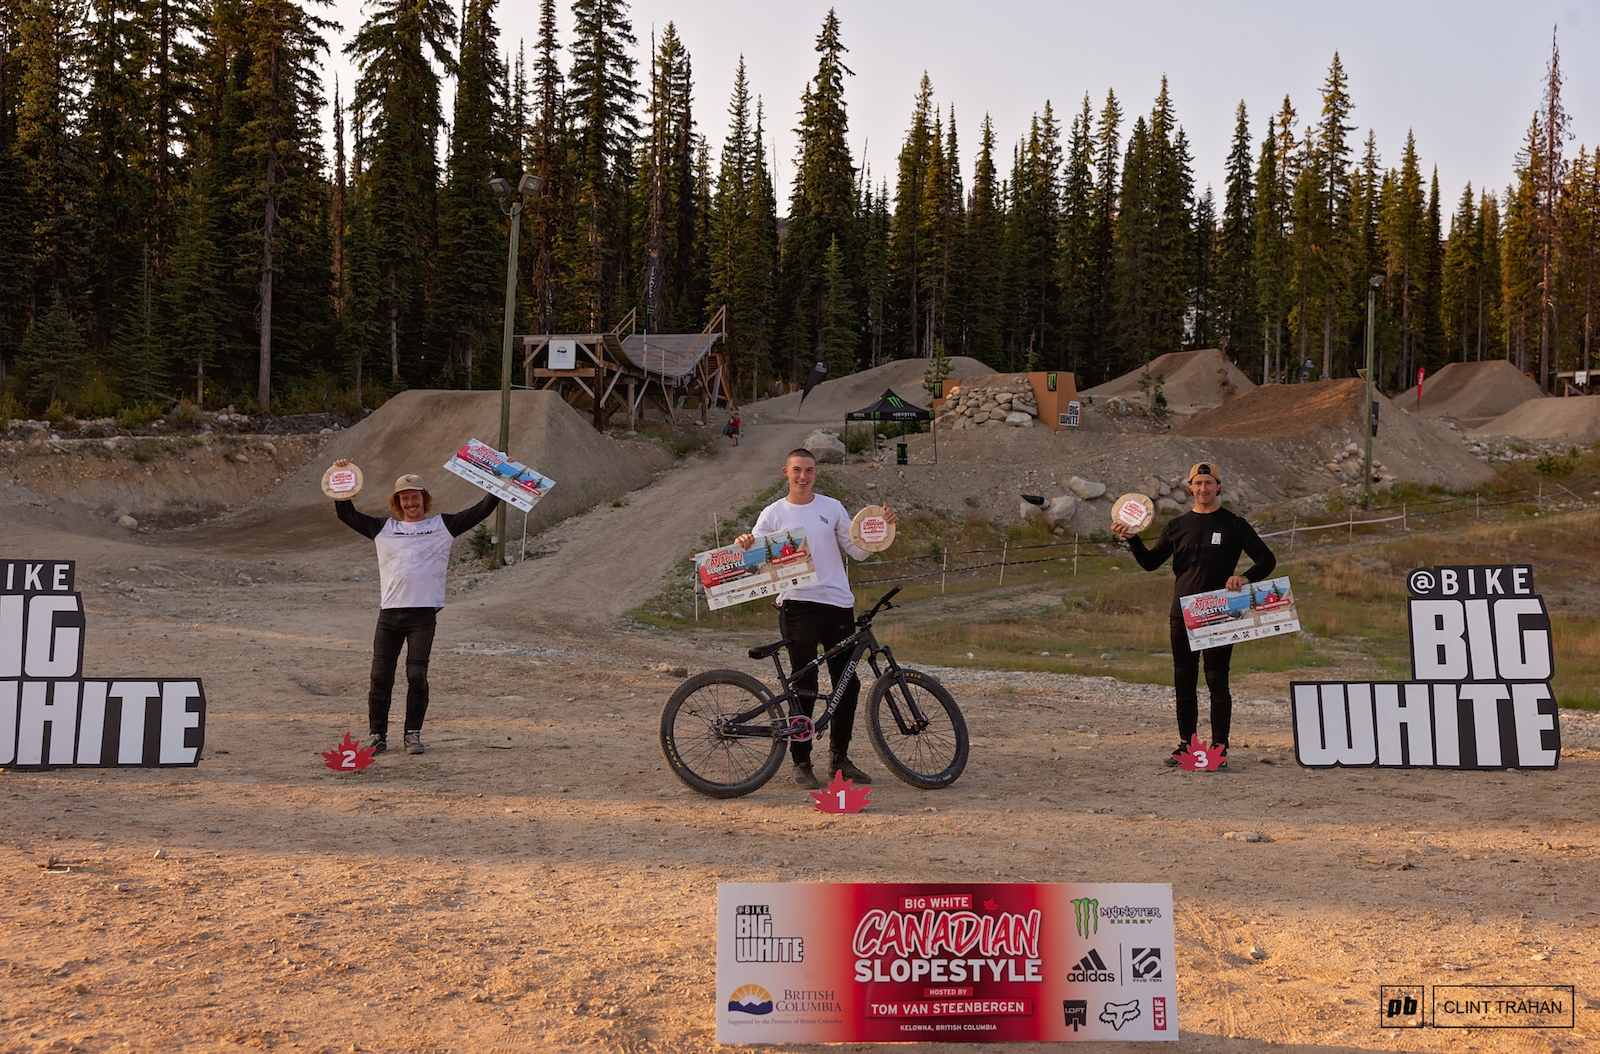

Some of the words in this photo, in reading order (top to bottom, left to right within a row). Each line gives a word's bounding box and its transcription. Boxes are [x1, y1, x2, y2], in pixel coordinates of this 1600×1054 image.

[705, 550, 743, 569] CANADIAN
[706, 560, 746, 575] SLOPESTYLE
[5, 563, 70, 591] IKE
[1411, 567, 1531, 596] @BIKE
[1190, 605, 1230, 618] SLOPESTYLE
[0, 595, 79, 677] IG
[1410, 598, 1551, 680] BIG
[0, 681, 200, 766] HITE
[1294, 683, 1557, 767] WHITE
[341, 749, 357, 768] 2
[1194, 750, 1209, 768] 3
[836, 790, 846, 810] 1
[904, 898, 926, 909] BIG
[930, 896, 969, 908] WHITE
[1100, 905, 1162, 919] MONSTER
[736, 914, 773, 939] BIG
[852, 908, 1042, 960] CANADIAN
[736, 937, 804, 962] WHITE
[854, 958, 1043, 982] SLOPESTYLE
[1066, 970, 1115, 982] adidas
[784, 989, 835, 1000] BRITISH
[775, 1000, 842, 1013] COLUMBIA
[871, 1003, 898, 1014] TOM
[902, 1003, 928, 1014] VAN
[932, 1002, 1025, 1013] STEENBERGEN
[1155, 998, 1165, 1026] CLIF
